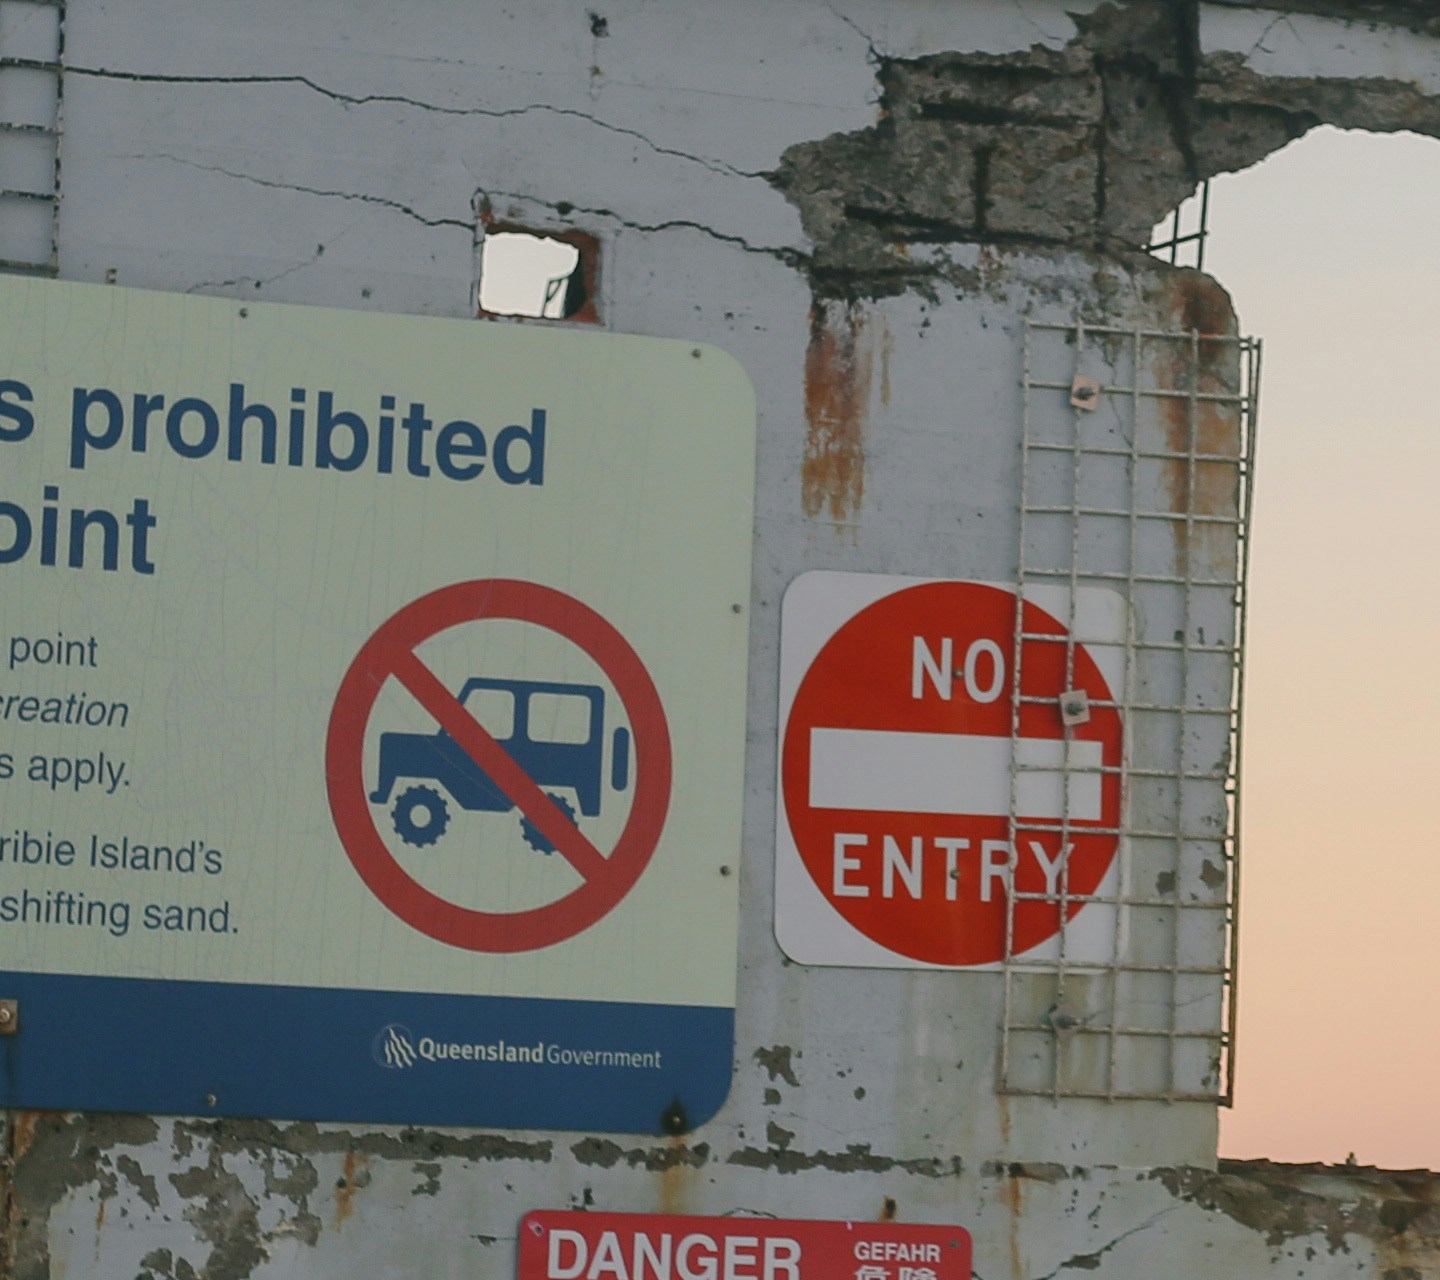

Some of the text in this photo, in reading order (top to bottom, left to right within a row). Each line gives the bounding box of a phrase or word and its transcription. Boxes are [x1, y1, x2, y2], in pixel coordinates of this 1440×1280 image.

[70, 383, 546, 485] prohibited
[10, 632, 97, 670] point
[912, 636, 1004, 703] NO
[28, 752, 129, 794] apply.
[833, 832, 1076, 905] ENTRY
[0, 889, 129, 936] shifting
[144, 901, 237, 933] sand.
[418, 1037, 661, 1069] Queensland Government
[854, 1240, 941, 1263] GEFAHR
